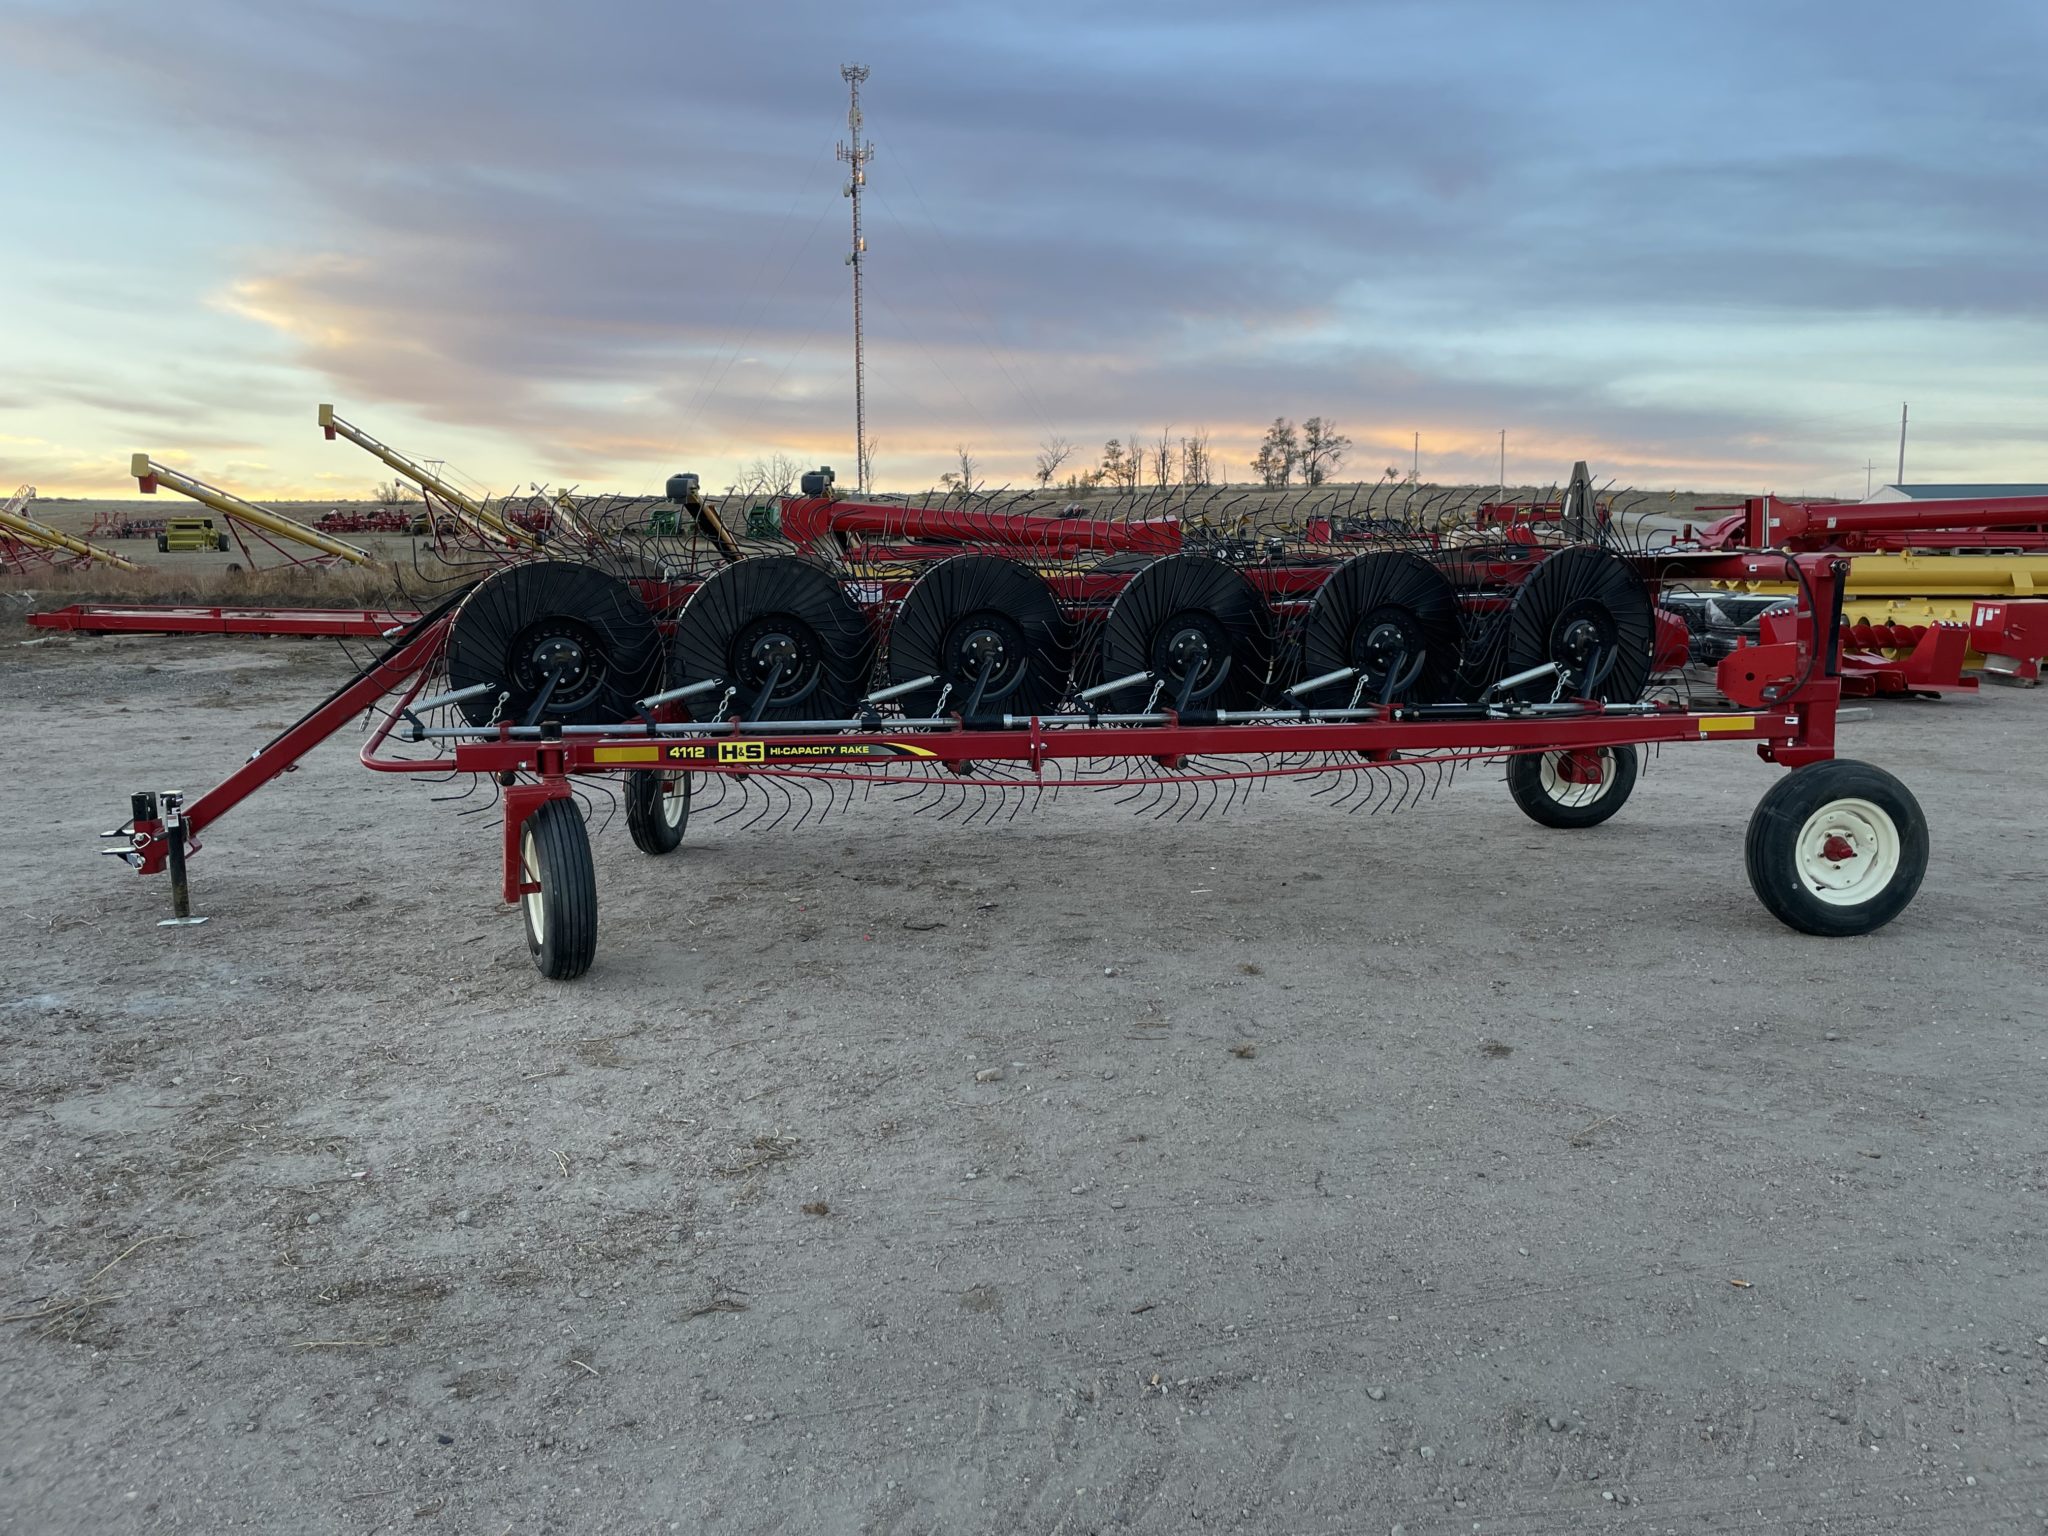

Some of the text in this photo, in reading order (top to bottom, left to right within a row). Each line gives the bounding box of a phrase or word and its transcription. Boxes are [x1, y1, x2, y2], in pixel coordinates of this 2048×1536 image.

[669, 745, 870, 759] 4112 H&S HI-CAPACITY RAKE
